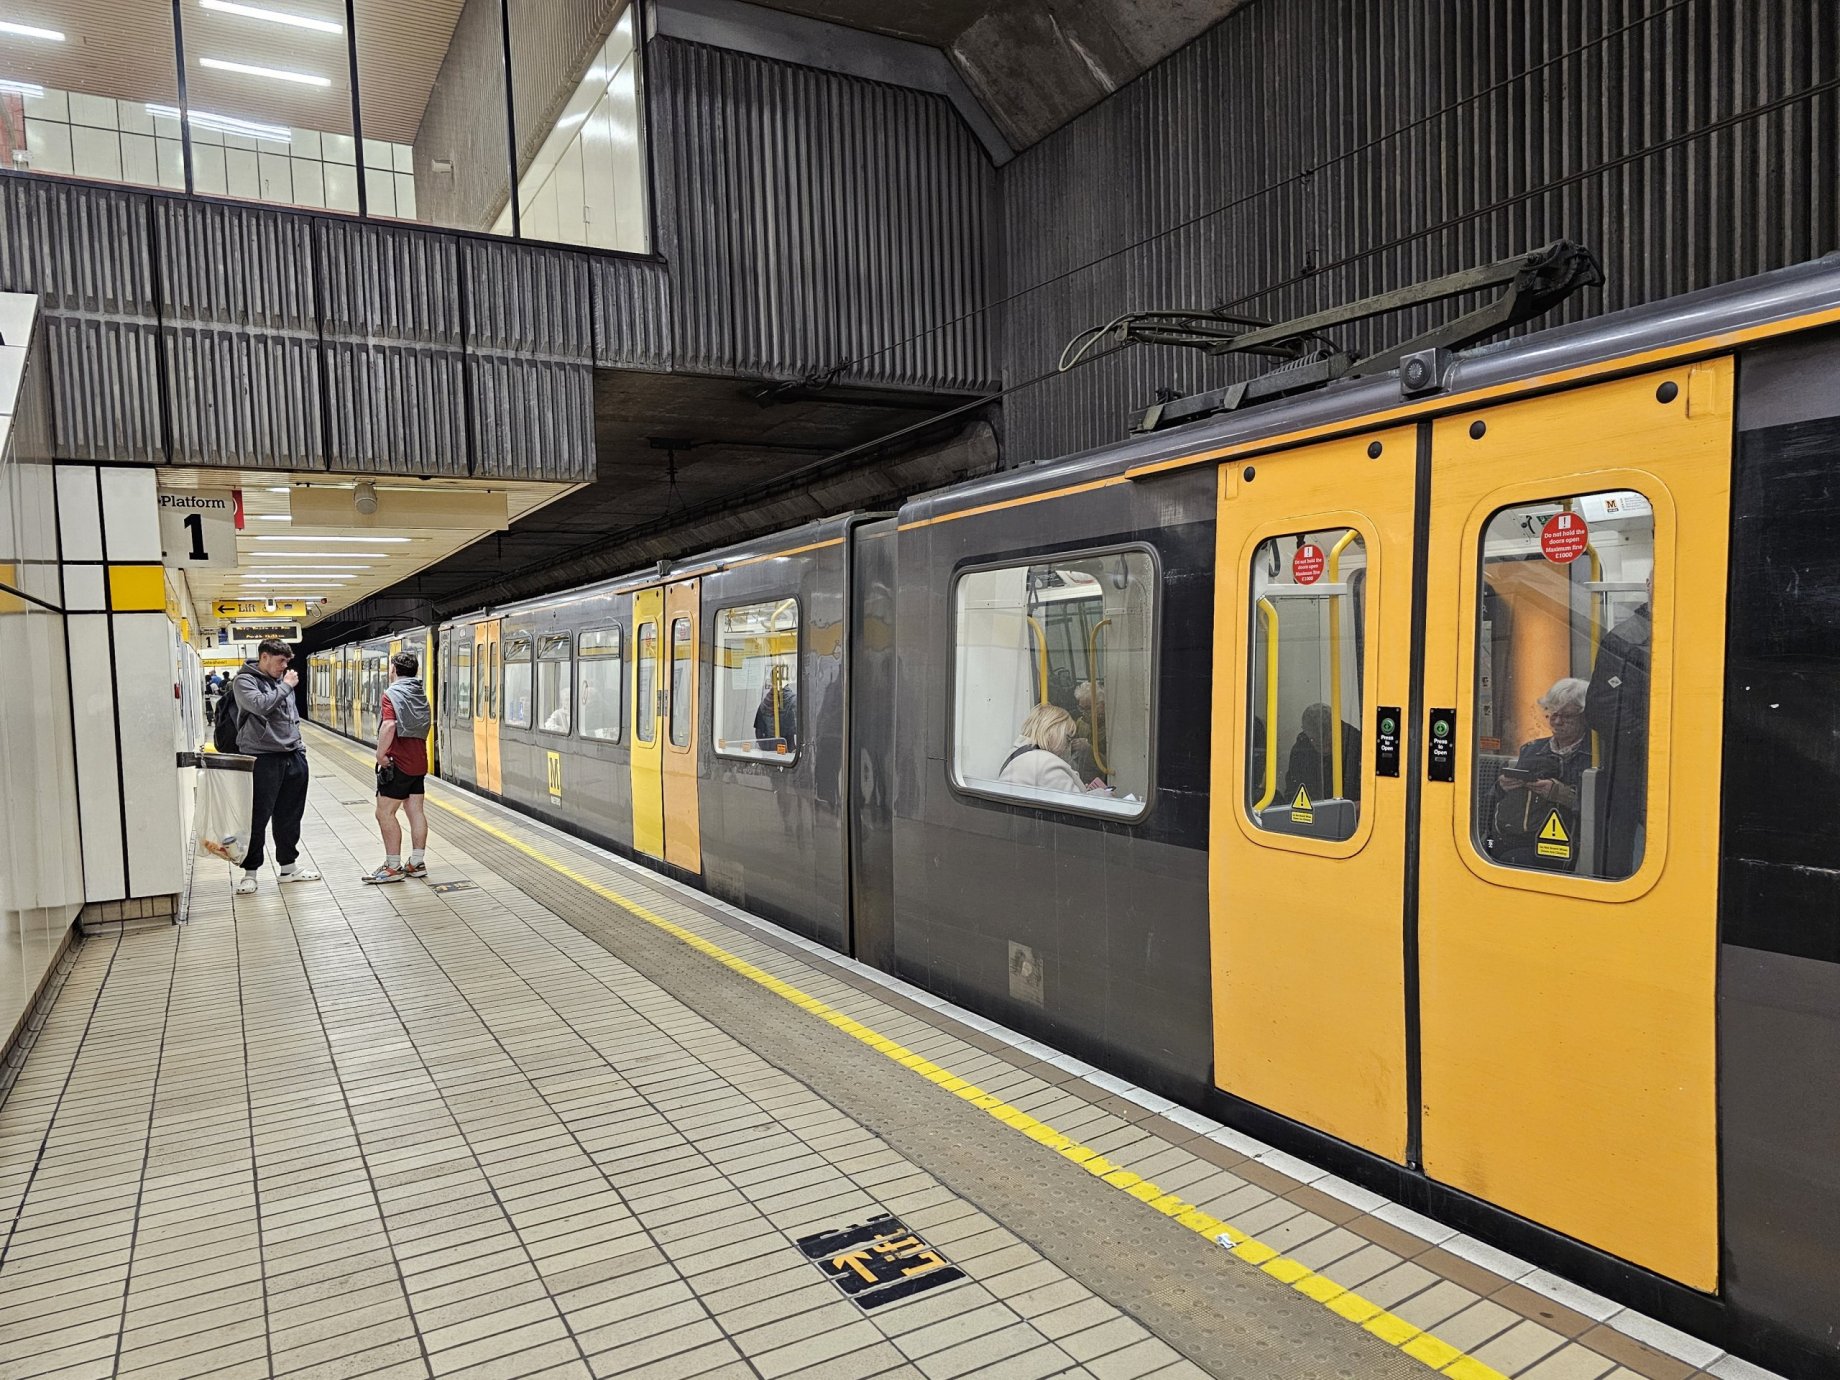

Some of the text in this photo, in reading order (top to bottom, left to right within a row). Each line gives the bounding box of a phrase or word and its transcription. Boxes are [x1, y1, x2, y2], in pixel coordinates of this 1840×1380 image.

[160, 495, 226, 509] Platform
[183, 513, 209, 560] 1
[1562, 529, 1575, 537] hold
[238, 603, 256, 613] Lift
[205, 636, 212, 648] 1
